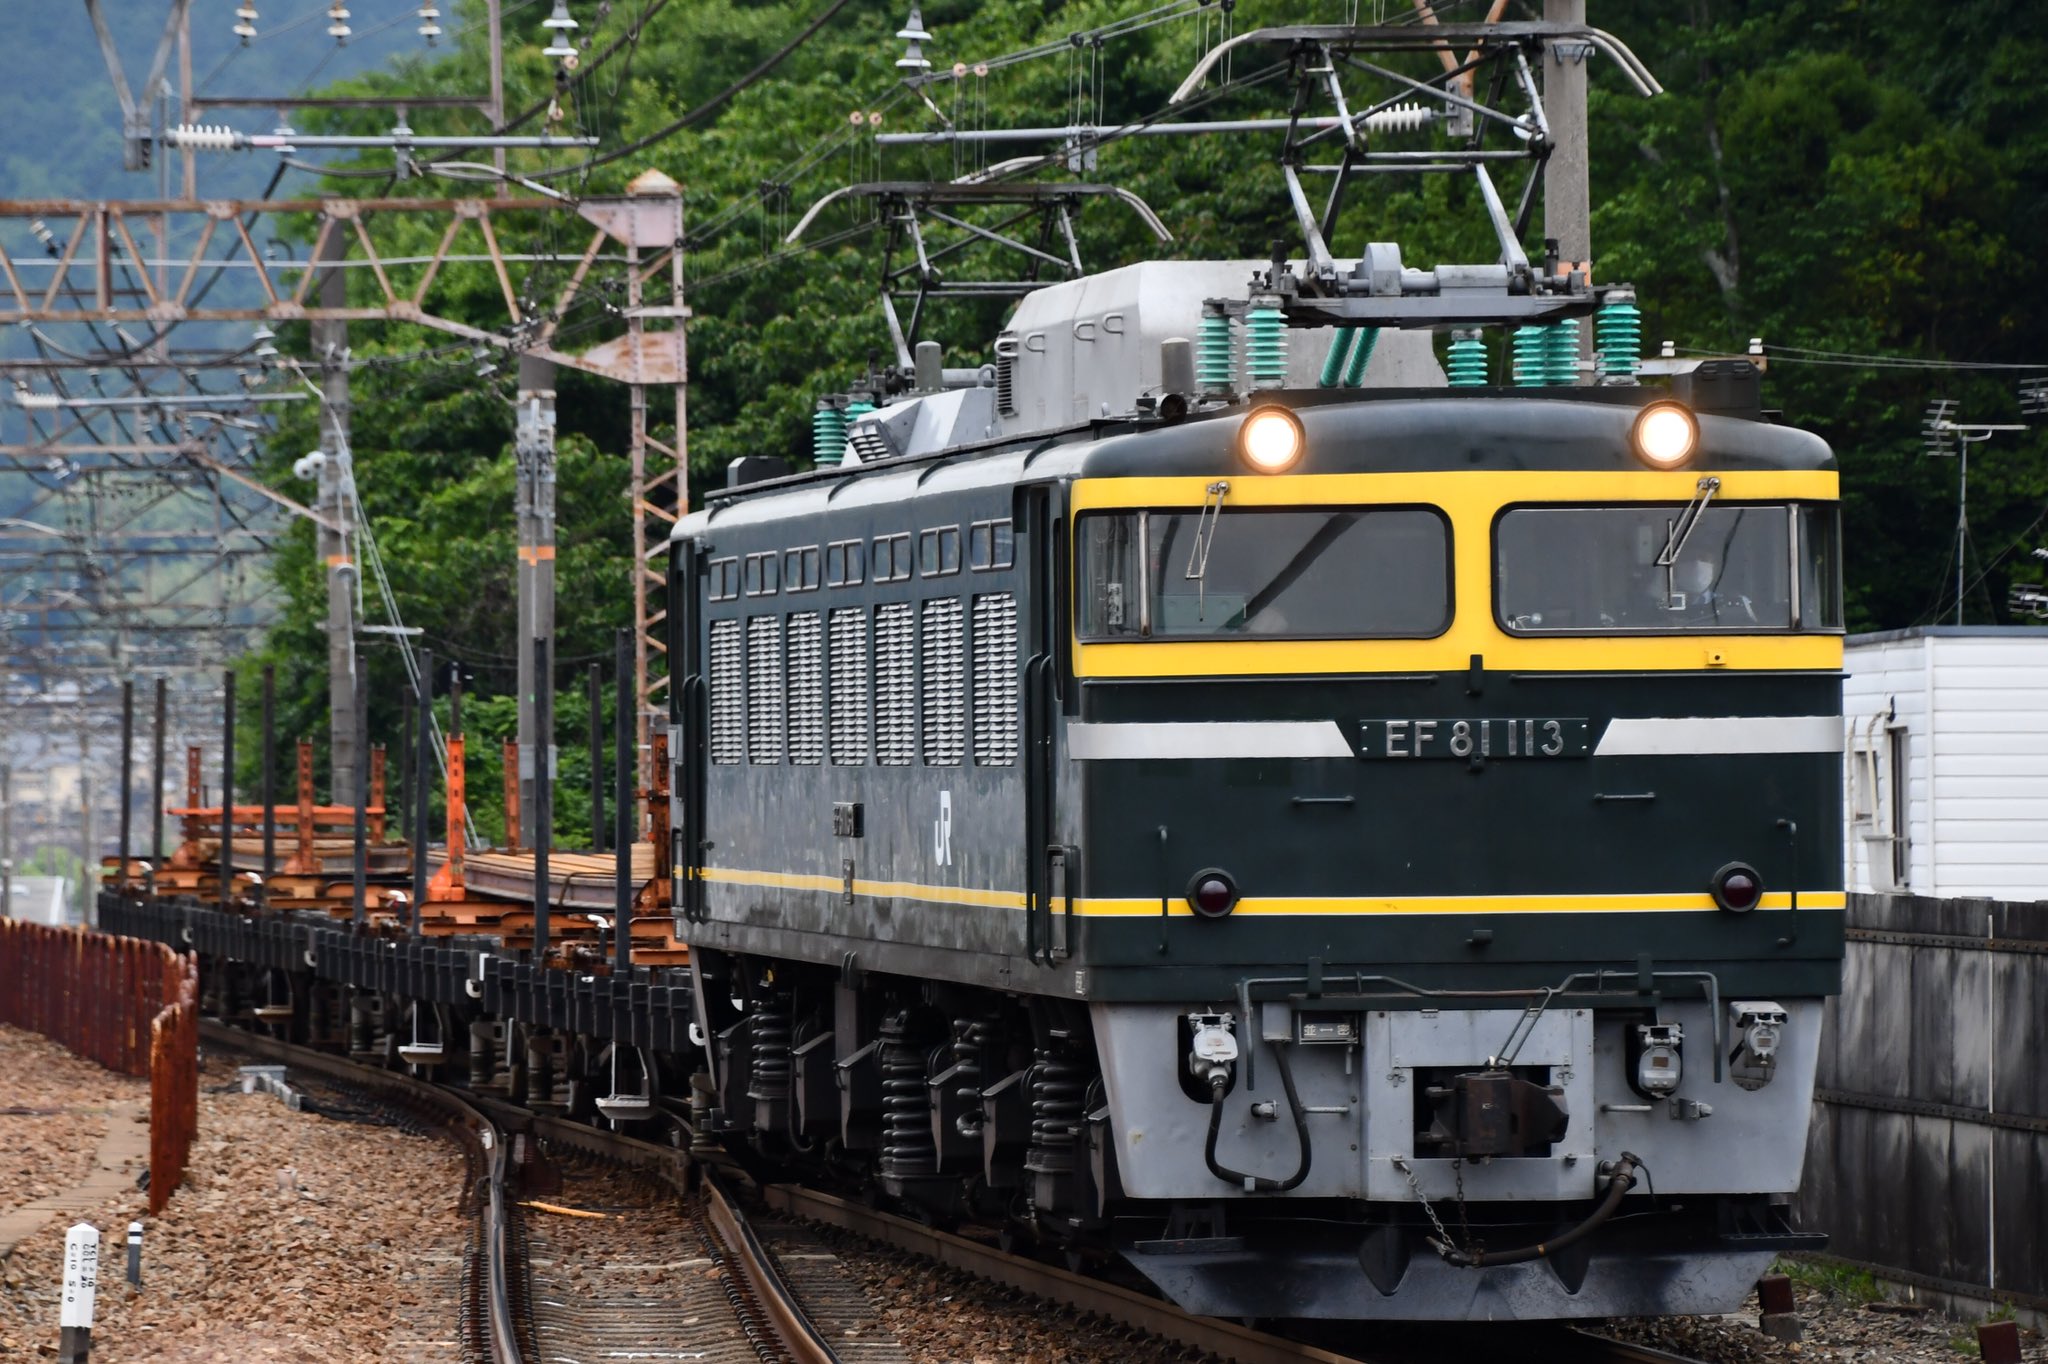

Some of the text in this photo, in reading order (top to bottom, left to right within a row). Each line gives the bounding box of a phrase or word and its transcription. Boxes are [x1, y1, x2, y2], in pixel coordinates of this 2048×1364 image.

[1386, 719, 1564, 757] EF 81 113
[935, 790, 952, 866] JR
